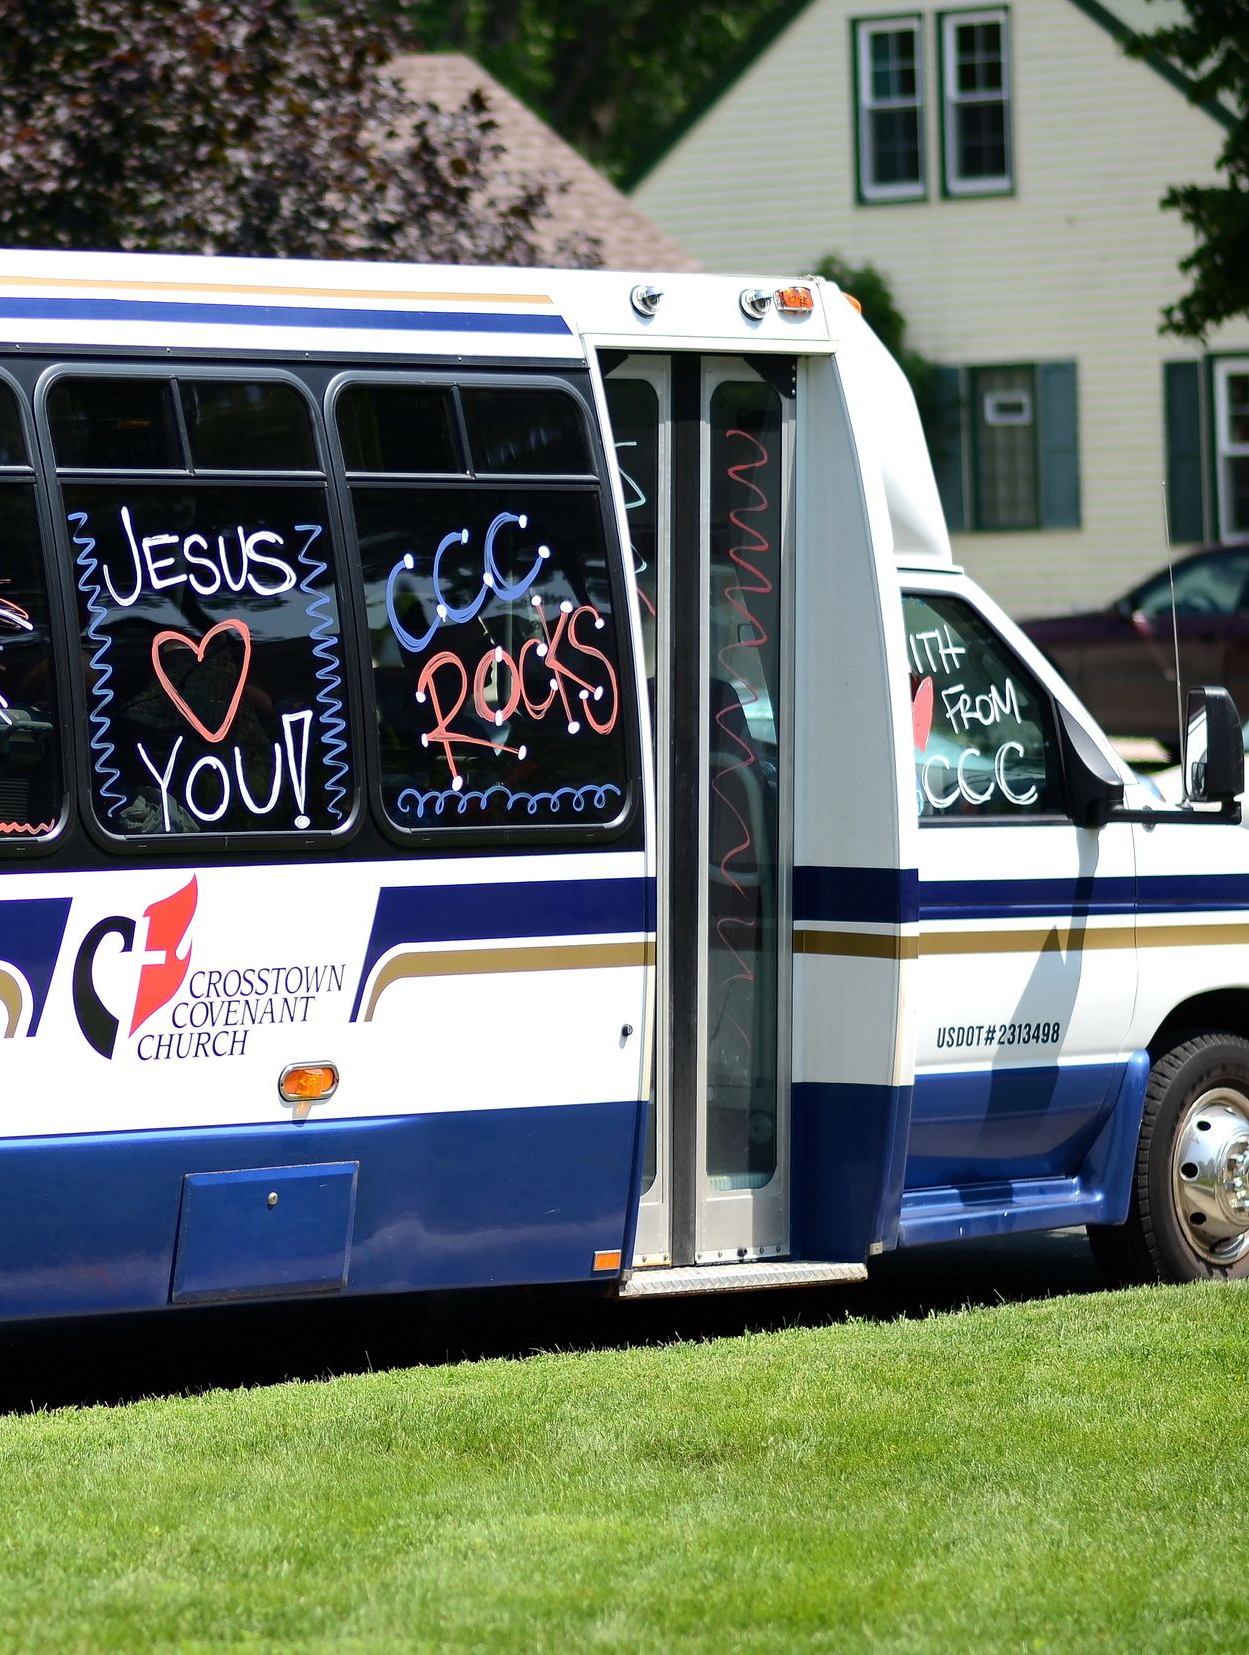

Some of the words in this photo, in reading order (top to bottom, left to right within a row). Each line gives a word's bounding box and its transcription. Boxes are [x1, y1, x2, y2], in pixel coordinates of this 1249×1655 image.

[103, 506, 297, 607] JESUS
[386, 512, 551, 652] CCC
[416, 594, 619, 791] ROCKS
[941, 677, 1022, 735] FROM
[137, 709, 313, 832] YOU!
[922, 741, 1039, 809] CCC
[171, 995, 316, 1028] COVENANT
[189, 963, 346, 999] CROSSTOWN
[137, 1029, 250, 1061] CHURCH
